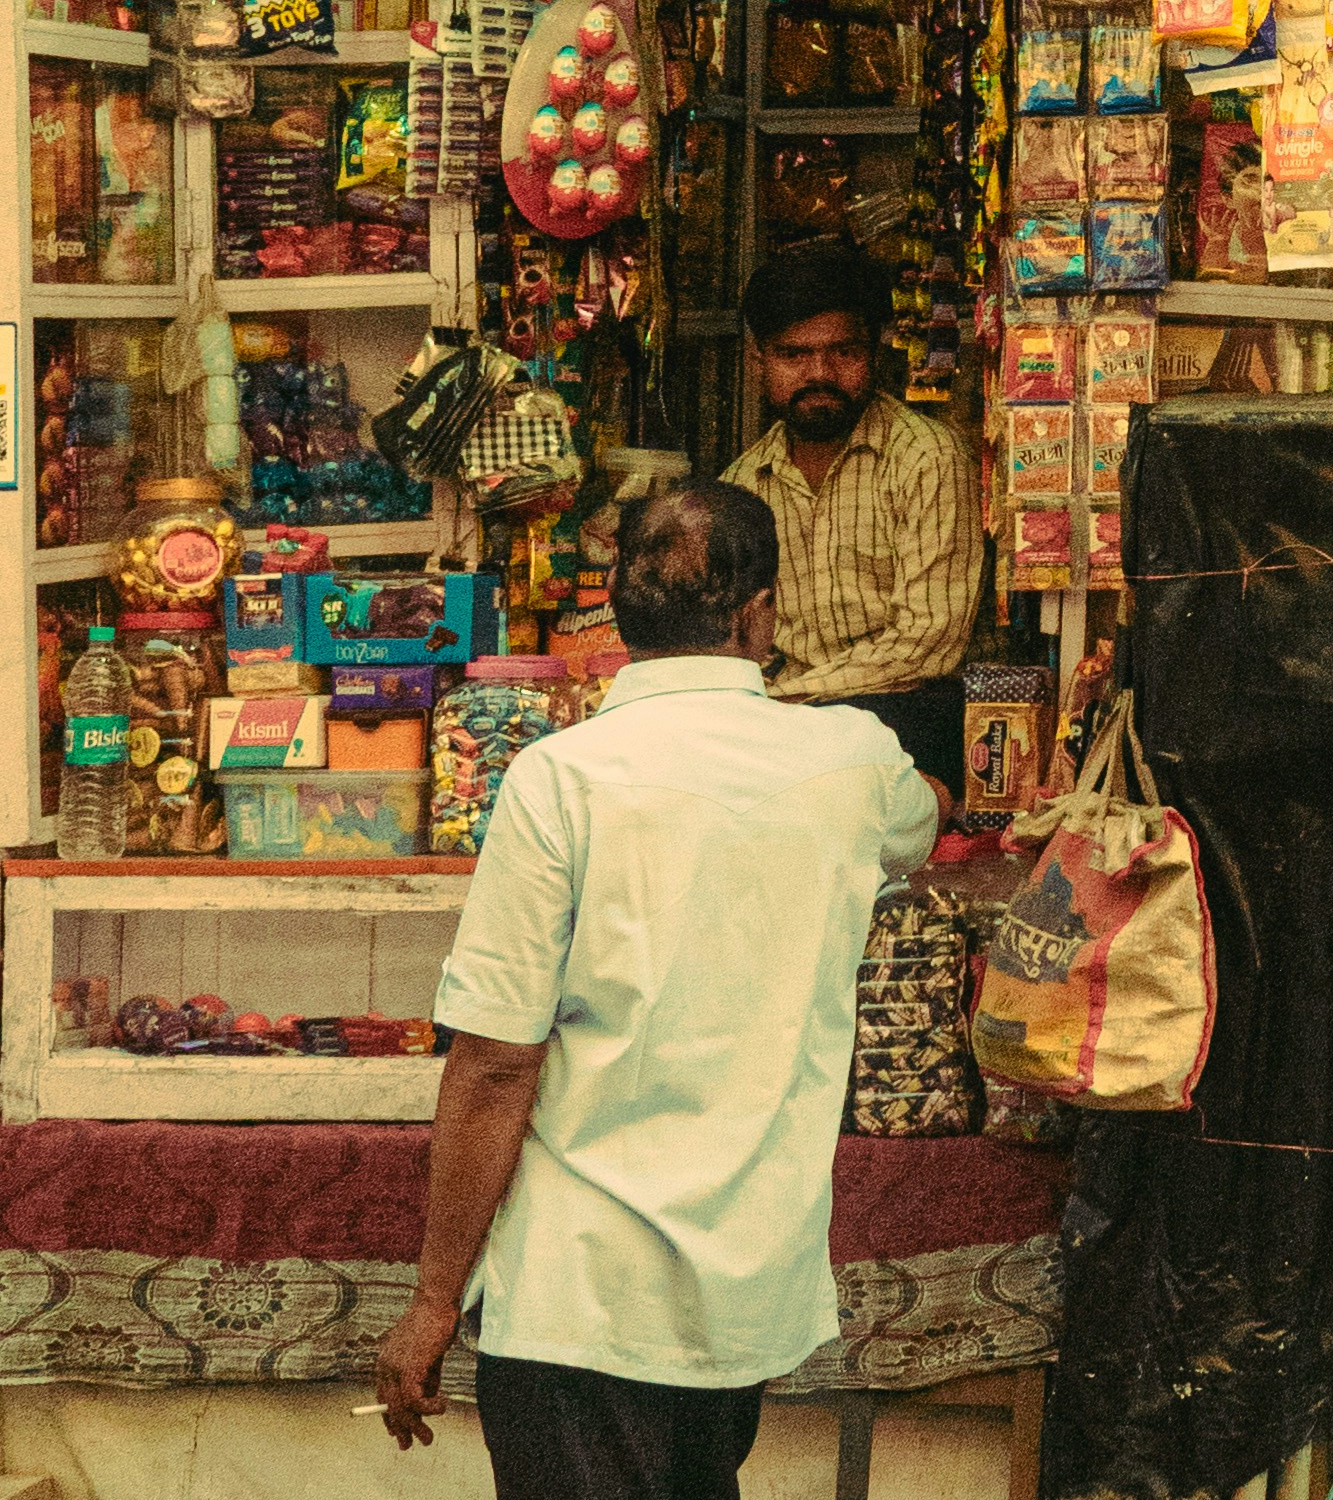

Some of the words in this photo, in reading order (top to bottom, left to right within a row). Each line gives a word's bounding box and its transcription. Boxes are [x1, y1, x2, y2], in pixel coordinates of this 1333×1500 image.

[246, 16, 266, 39] 3
[268, 1, 321, 31] TOYS
[238, 722, 289, 740] kismi
[988, 755, 1004, 793] Royal
